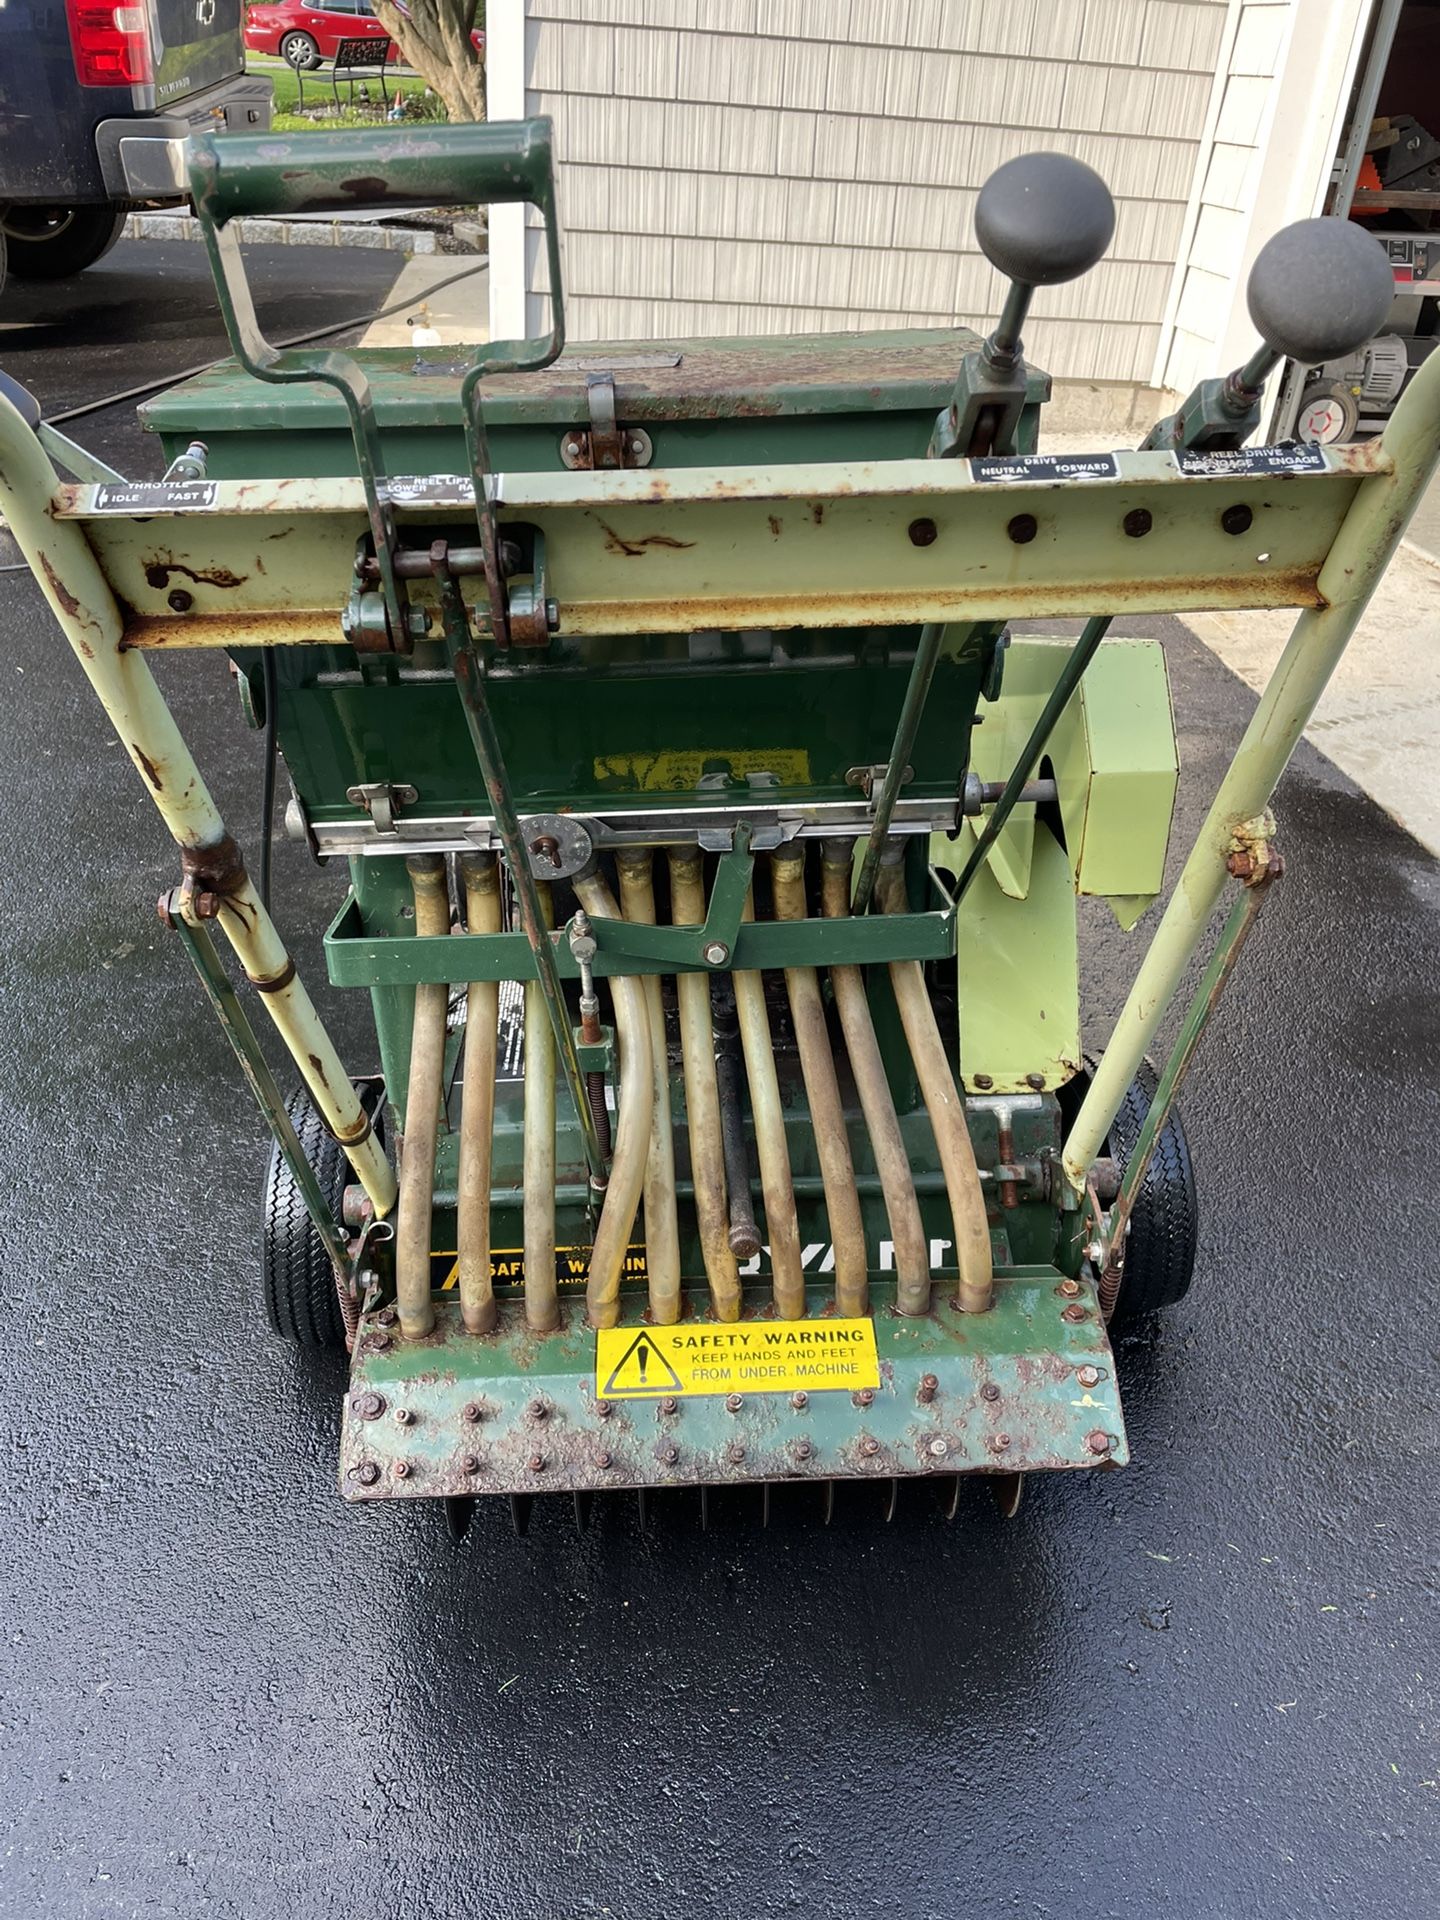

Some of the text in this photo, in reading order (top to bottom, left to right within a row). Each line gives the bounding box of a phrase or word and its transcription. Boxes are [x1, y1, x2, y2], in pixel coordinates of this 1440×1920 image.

[1210, 448, 1284, 458] REEL DRIVE
[1024, 457, 1057, 466] DRIVE
[1268, 456, 1320, 466] ENGAGE
[981, 463, 1109, 475] NEUTRAL FORWARD
[413, 477, 471, 485] REEL LIFT
[387, 484, 427, 493] LOWER
[111, 492, 199, 502] IDLE FAST
[672, 1329, 865, 1349] SAFETY WARNING
[692, 1347, 857, 1363] KEEP HANDS AND FEET
[692, 1362, 860, 1381] FROM UNDER MACHINE
